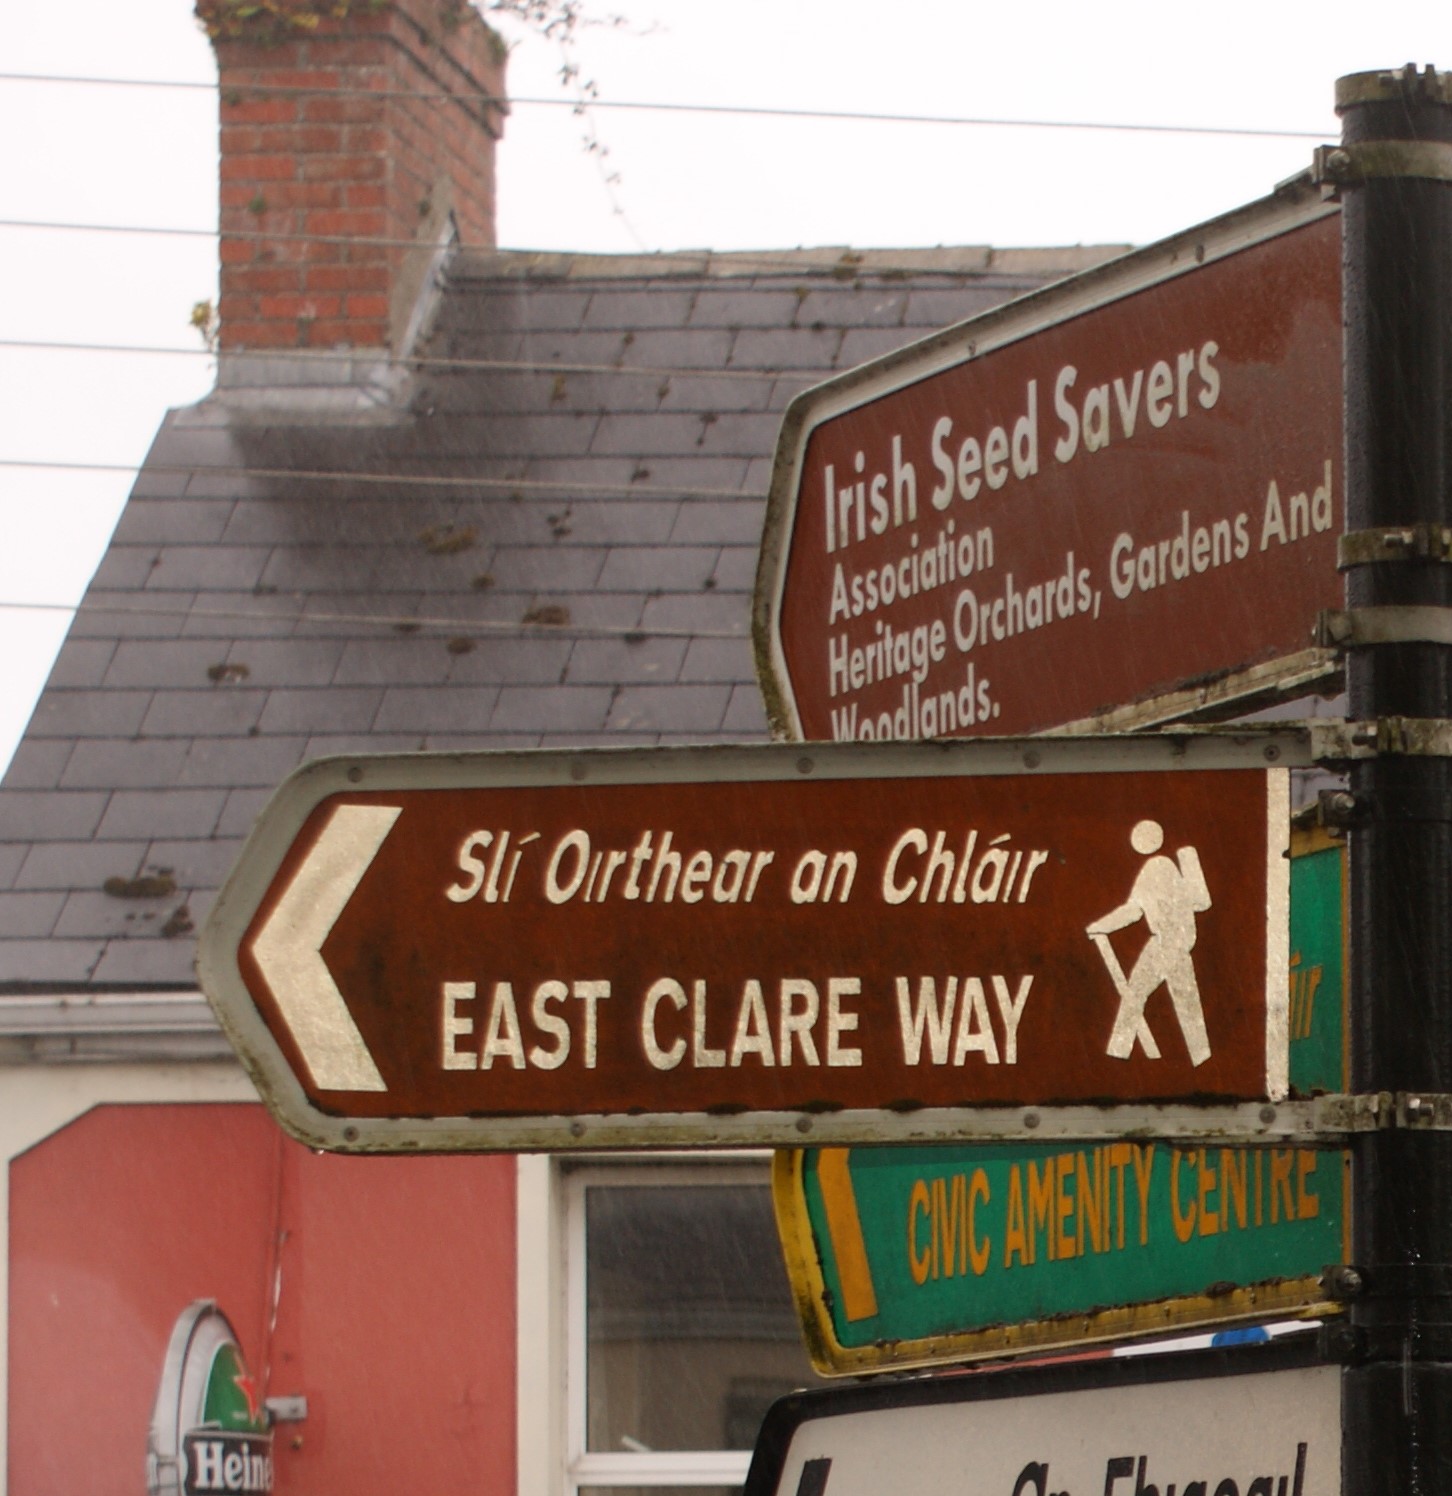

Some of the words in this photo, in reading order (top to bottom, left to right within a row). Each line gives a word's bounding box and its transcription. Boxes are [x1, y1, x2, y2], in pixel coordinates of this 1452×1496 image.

[824, 434, 918, 554] Irish
[931, 380, 1039, 511] Seed
[1053, 340, 1221, 464] Savers
[828, 518, 995, 626] Association
[828, 618, 947, 697] Heritage
[953, 551, 1101, 653] Orchards,
[1109, 510, 1250, 600] Gardens
[1260, 460, 1334, 551] And
[445, 829, 540, 904] Slí
[545, 828, 776, 905] Oirthear
[790, 846, 857, 905] an
[881, 824, 1051, 905] Chláir
[440, 979, 611, 1071] EAST
[641, 975, 861, 1071] CLARE
[896, 974, 1034, 1067] WAY
[907, 1167, 990, 1286] CIVIC
[1004, 1142, 1156, 1269] AMENITY
[1170, 1147, 1319, 1244] CENTRE
